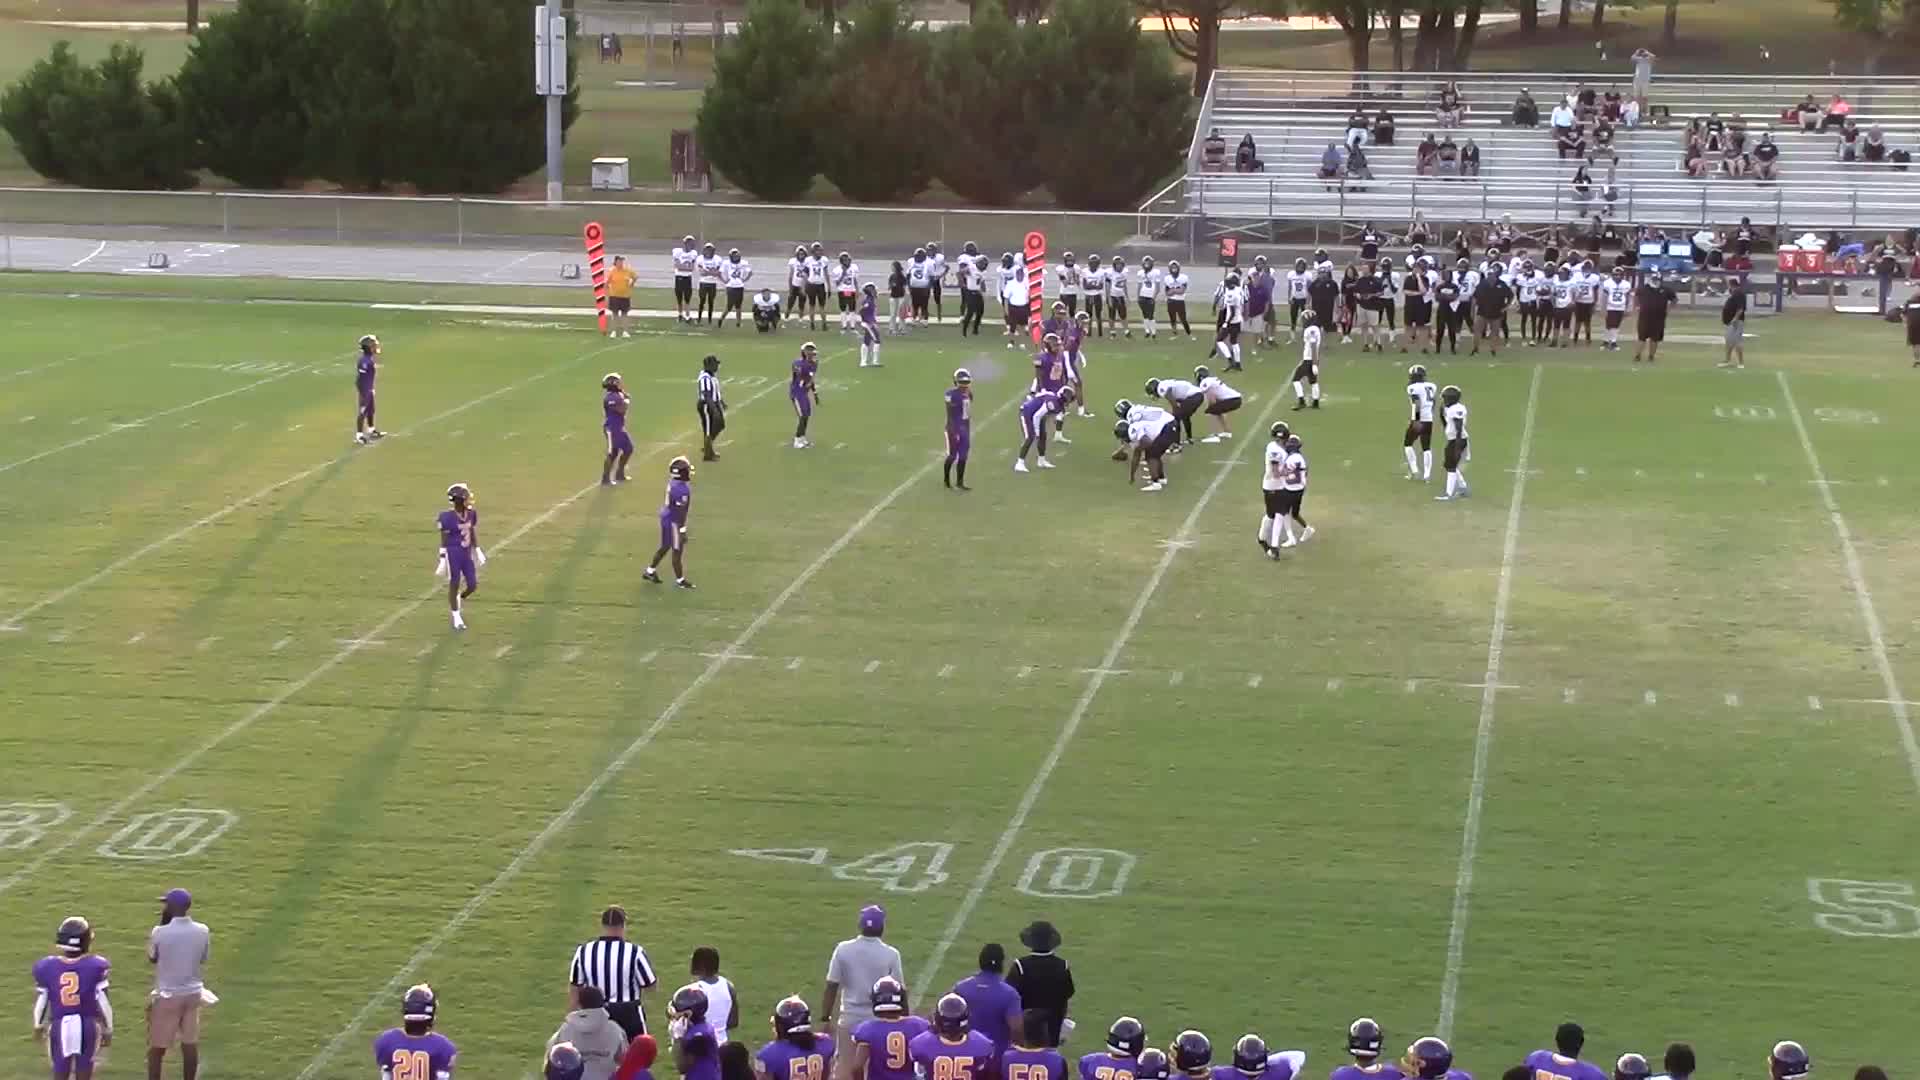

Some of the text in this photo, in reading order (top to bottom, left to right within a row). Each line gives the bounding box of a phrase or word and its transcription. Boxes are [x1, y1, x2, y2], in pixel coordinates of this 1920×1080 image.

[1220, 238, 1236, 257] 3
[60, 970, 80, 1006] 2
[392, 1049, 430, 1080] 20
[886, 1031, 906, 1068] 9
[933, 1056, 974, 1080] 85
